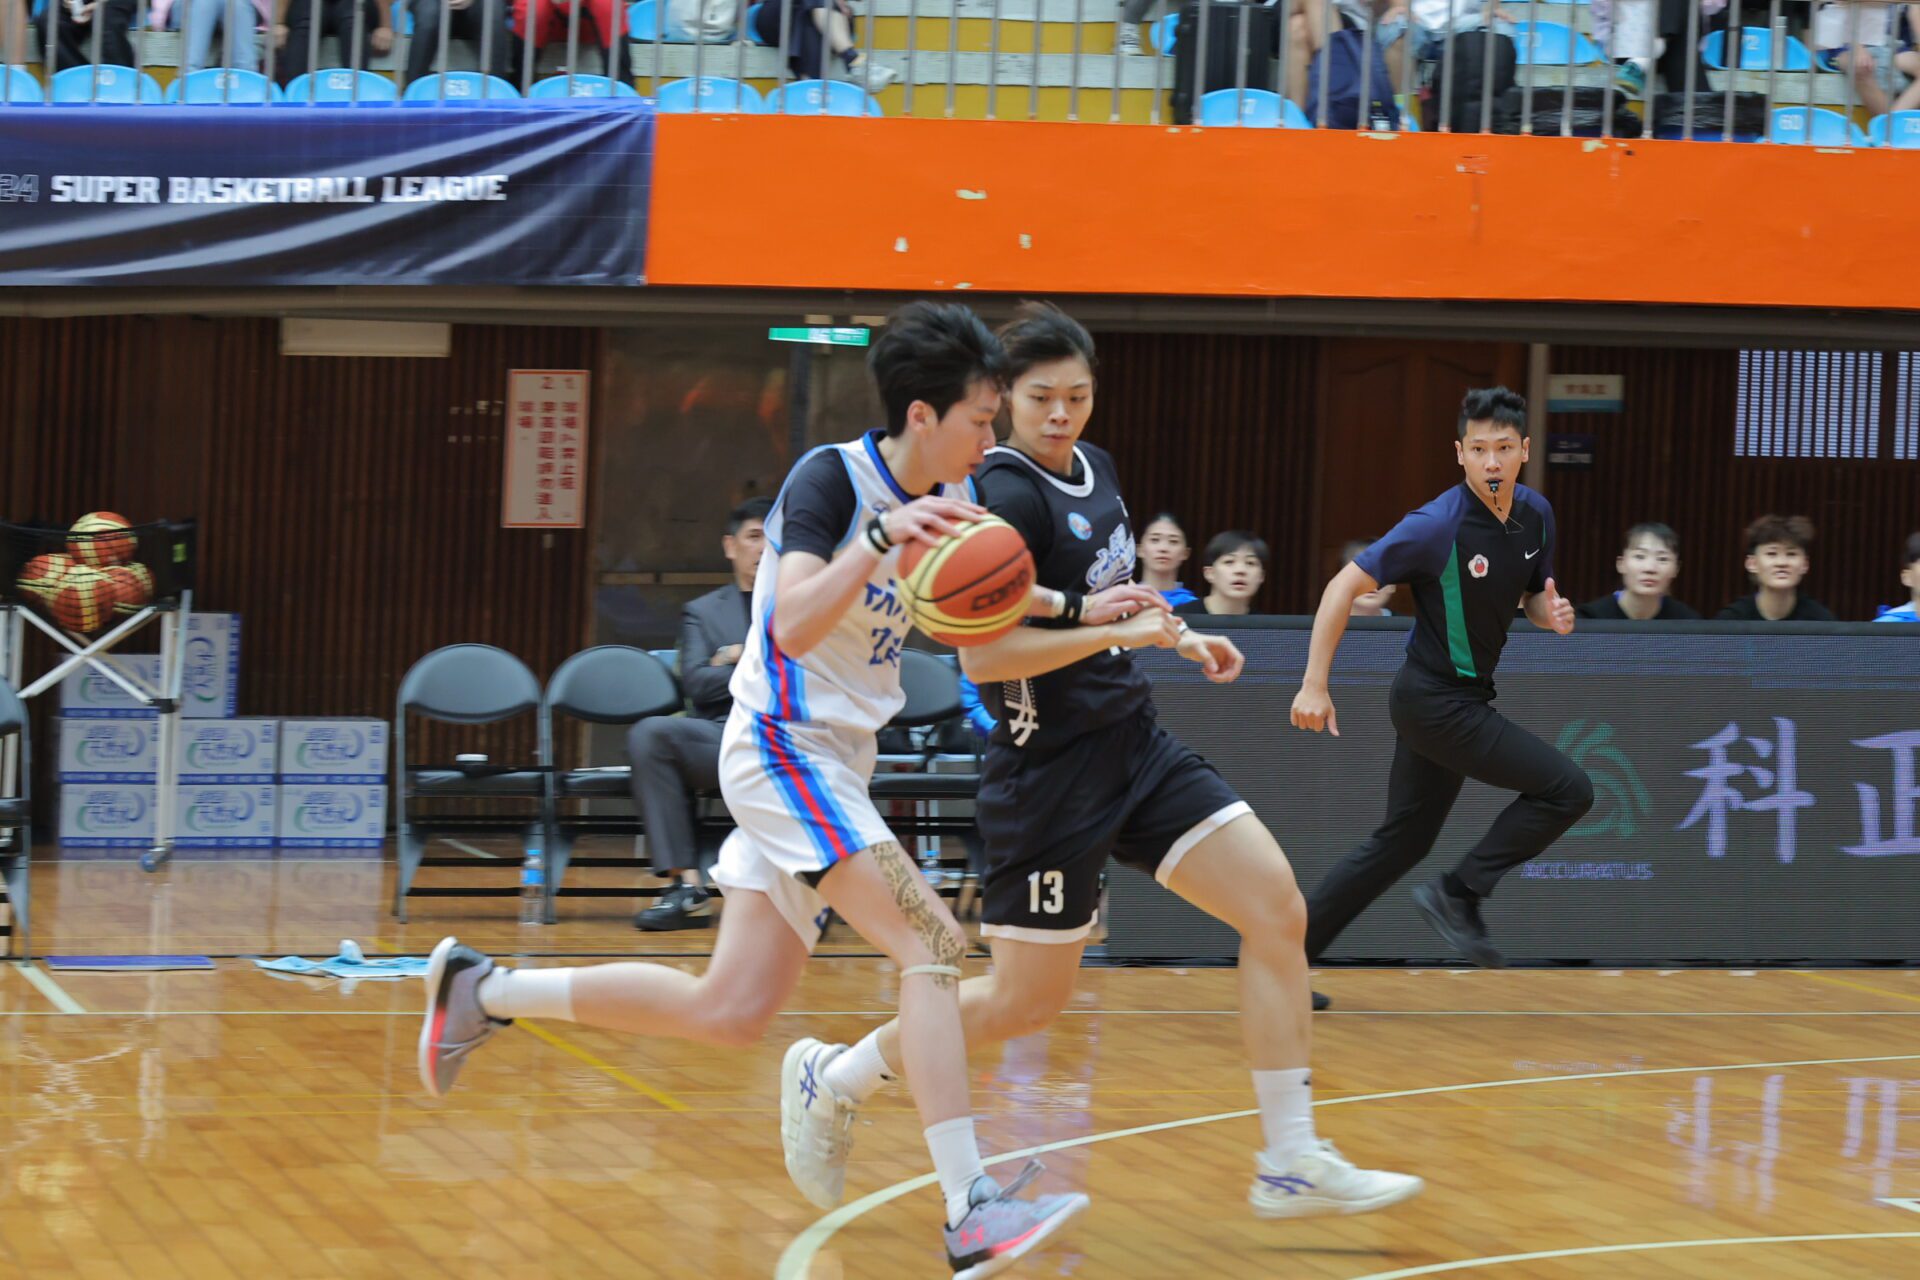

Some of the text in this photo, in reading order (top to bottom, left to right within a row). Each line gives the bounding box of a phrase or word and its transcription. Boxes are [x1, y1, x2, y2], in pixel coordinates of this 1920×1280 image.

[51, 175, 160, 203] SUPER
[168, 176, 375, 203] BASKETBALL
[381, 174, 509, 202] LEAGUE
[1027, 870, 1064, 914] 13
